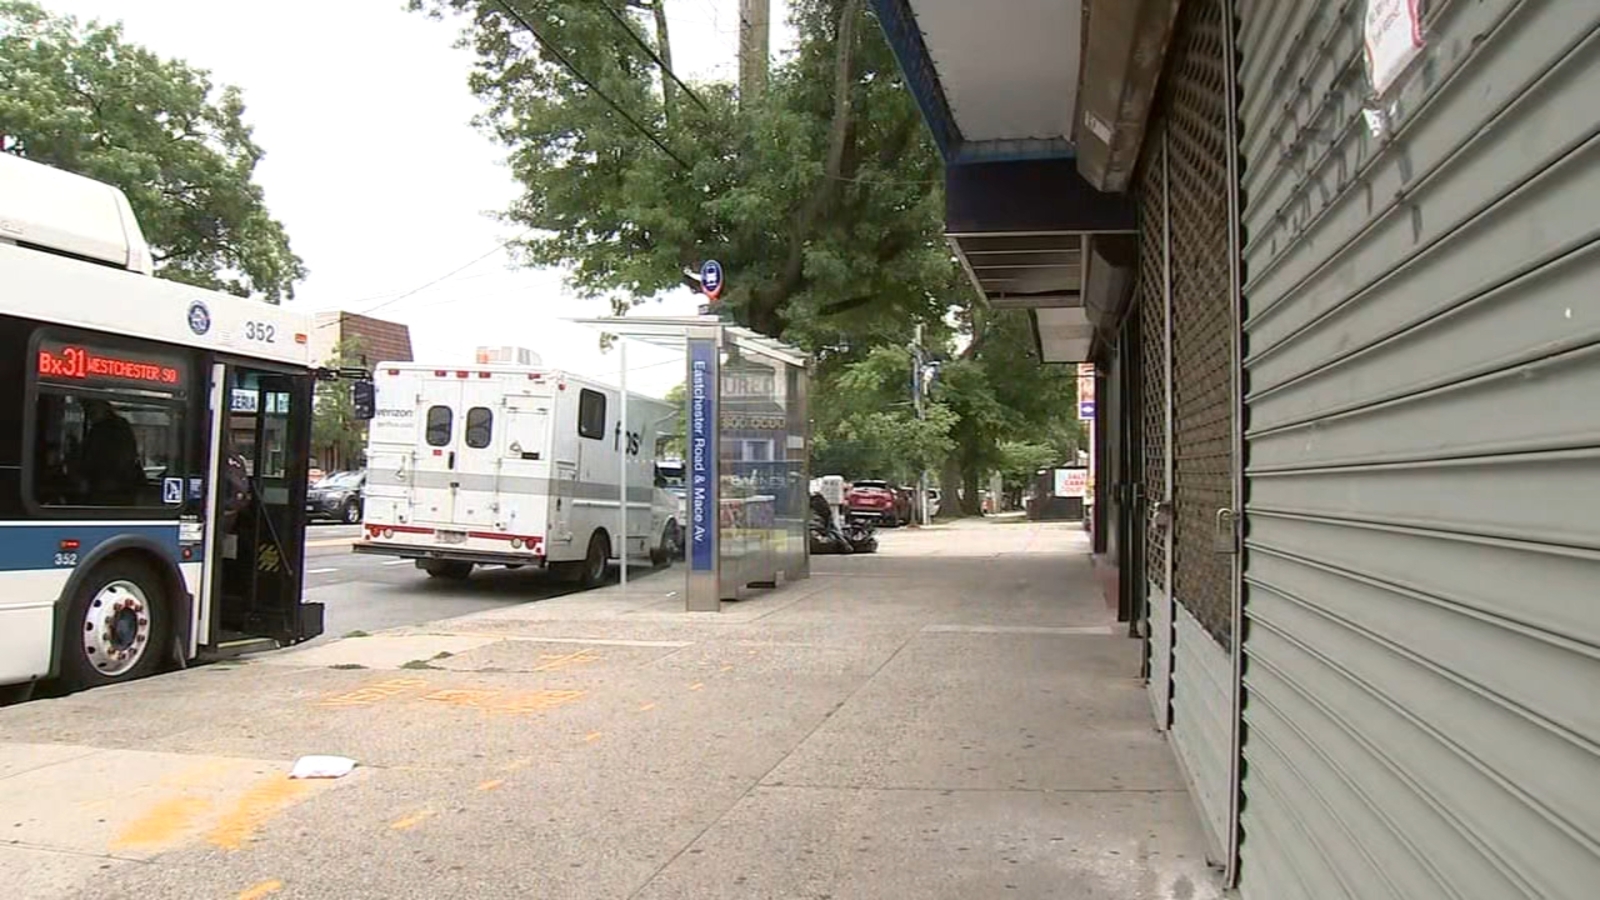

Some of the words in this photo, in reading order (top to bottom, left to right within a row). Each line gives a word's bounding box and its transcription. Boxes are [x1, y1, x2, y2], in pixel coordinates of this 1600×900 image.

[245, 320, 276, 344] 352
[38, 347, 86, 378] Bx31
[86, 357, 160, 381] WESTCHESTER
[694, 360, 706, 437] Eastchester
[694, 438, 706, 471] Road
[694, 474, 706, 484] &
[694, 524, 706, 542] Av
[54, 552, 79, 566] 352
